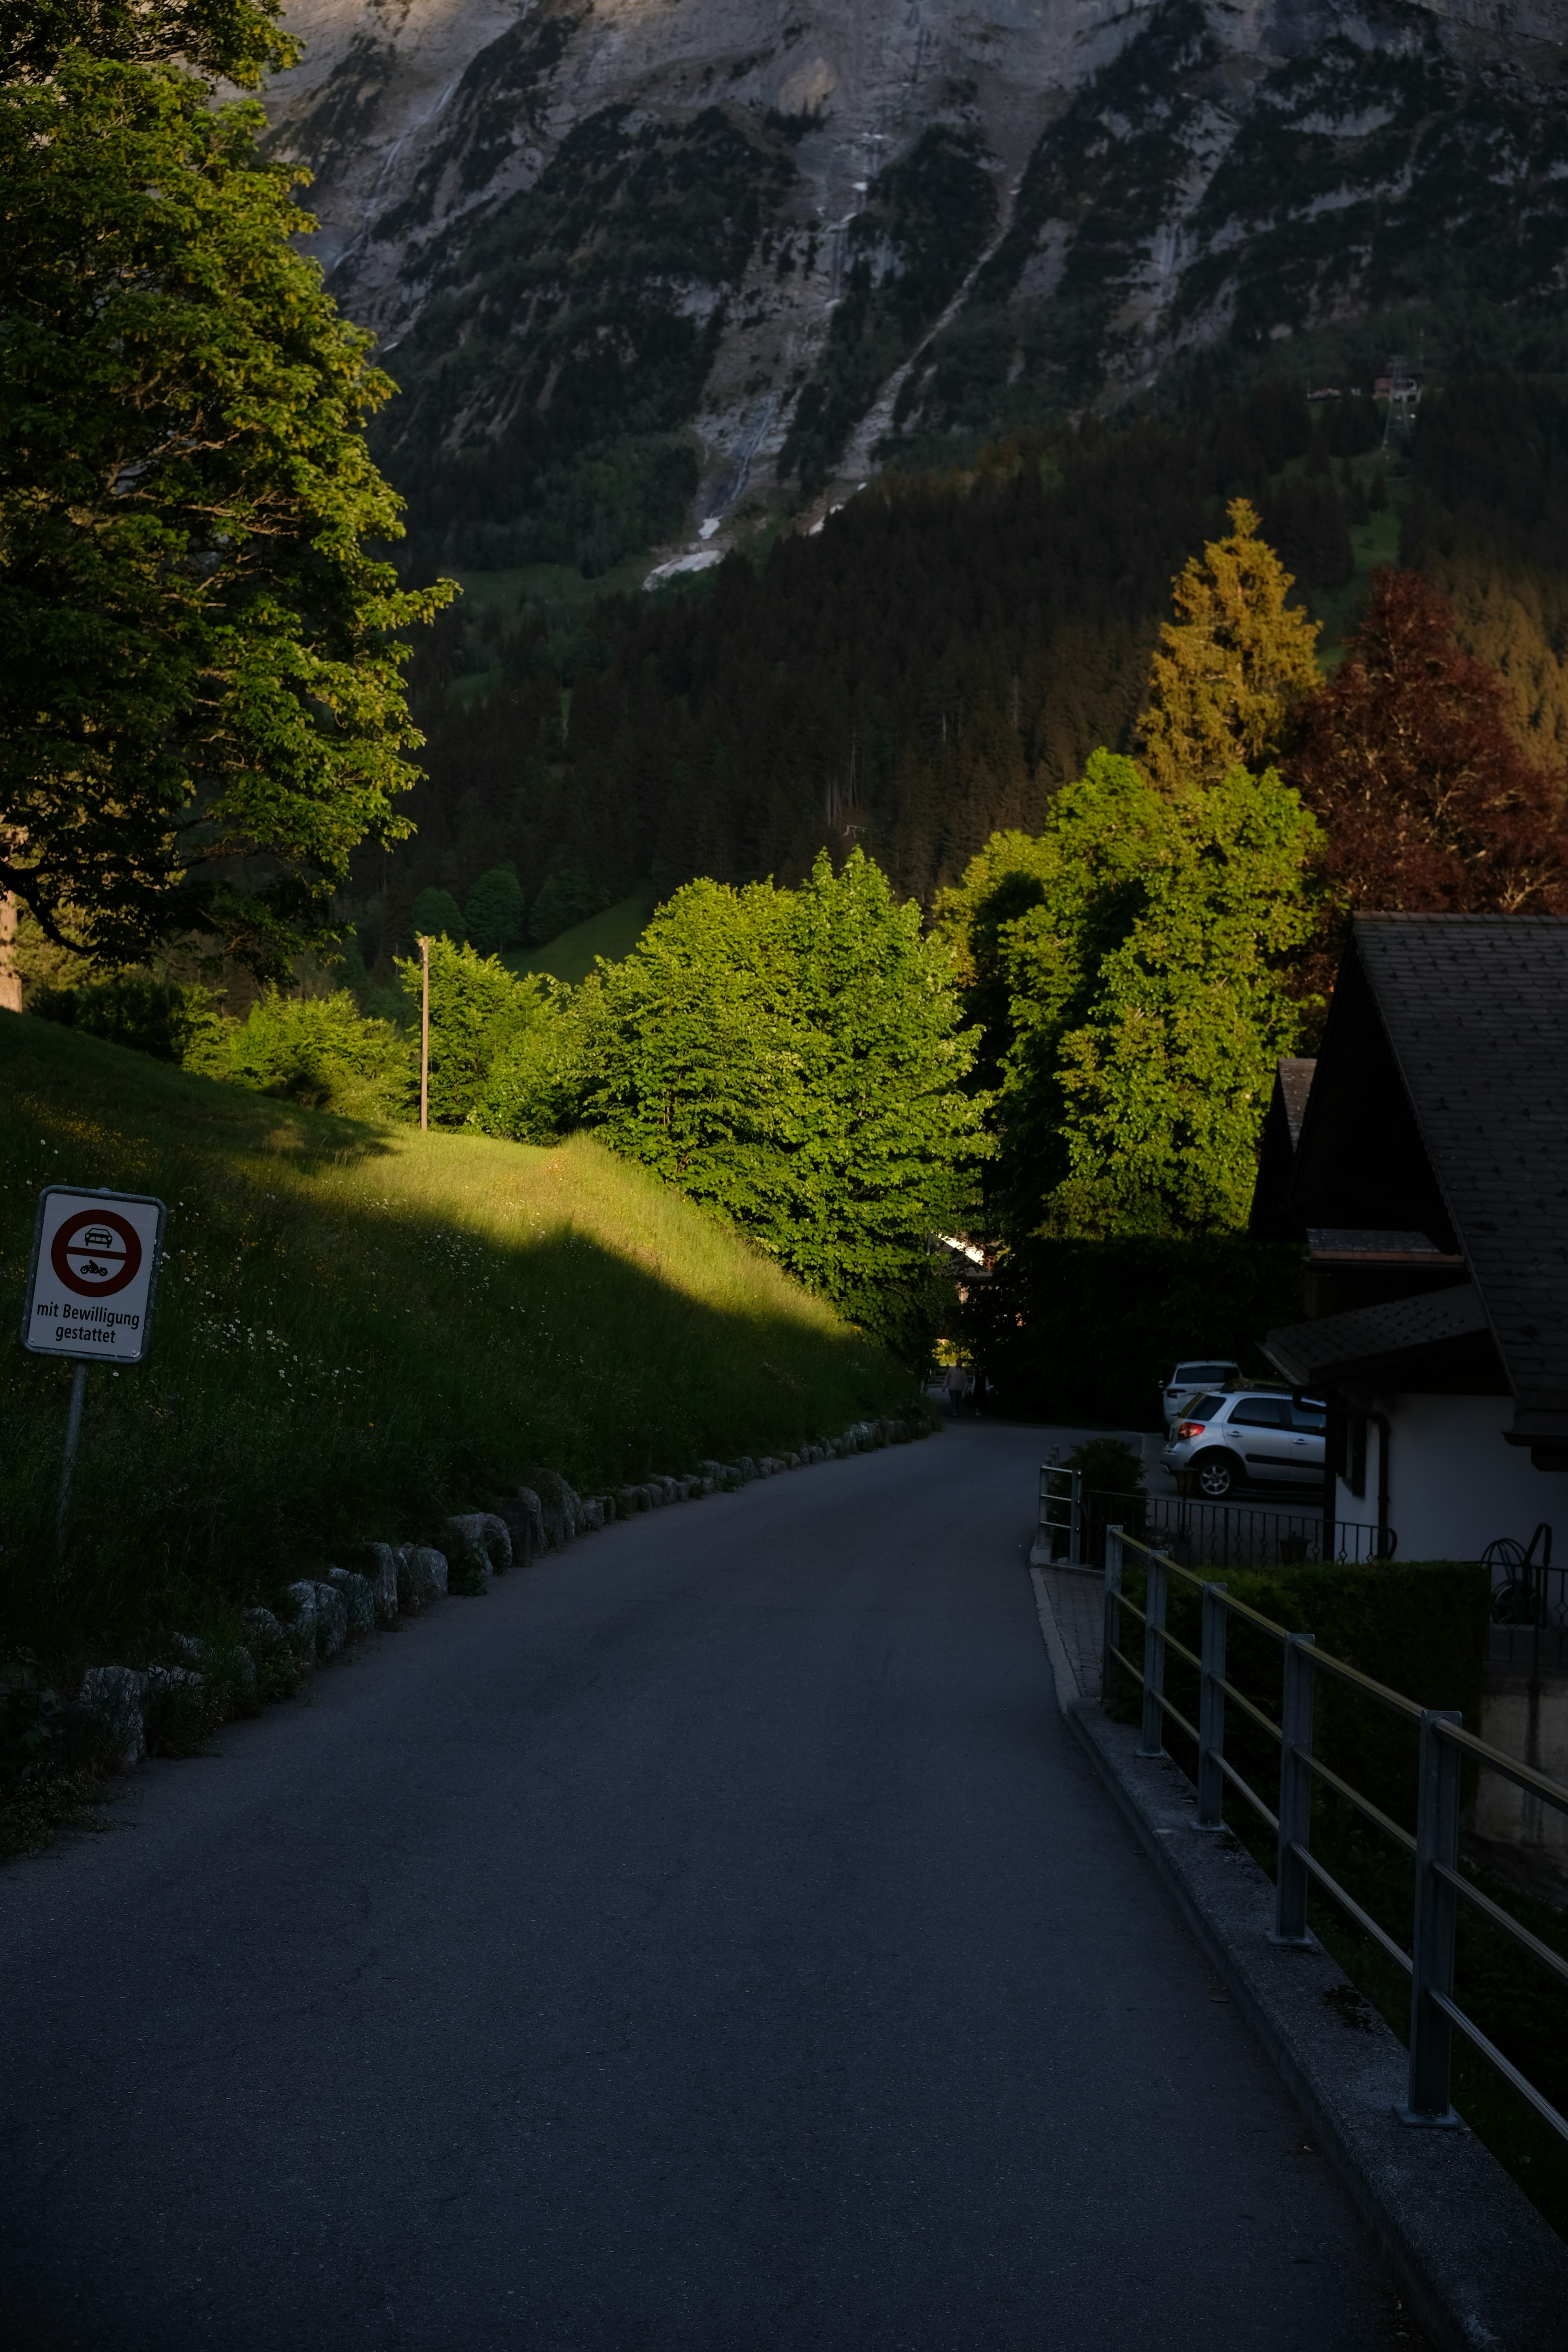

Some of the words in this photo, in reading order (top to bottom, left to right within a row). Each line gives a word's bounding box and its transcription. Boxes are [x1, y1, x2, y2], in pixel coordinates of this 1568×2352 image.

[37, 1302, 58, 1317] mit
[63, 1304, 140, 1330] Bewilligung
[56, 1327, 116, 1343] gestattet
